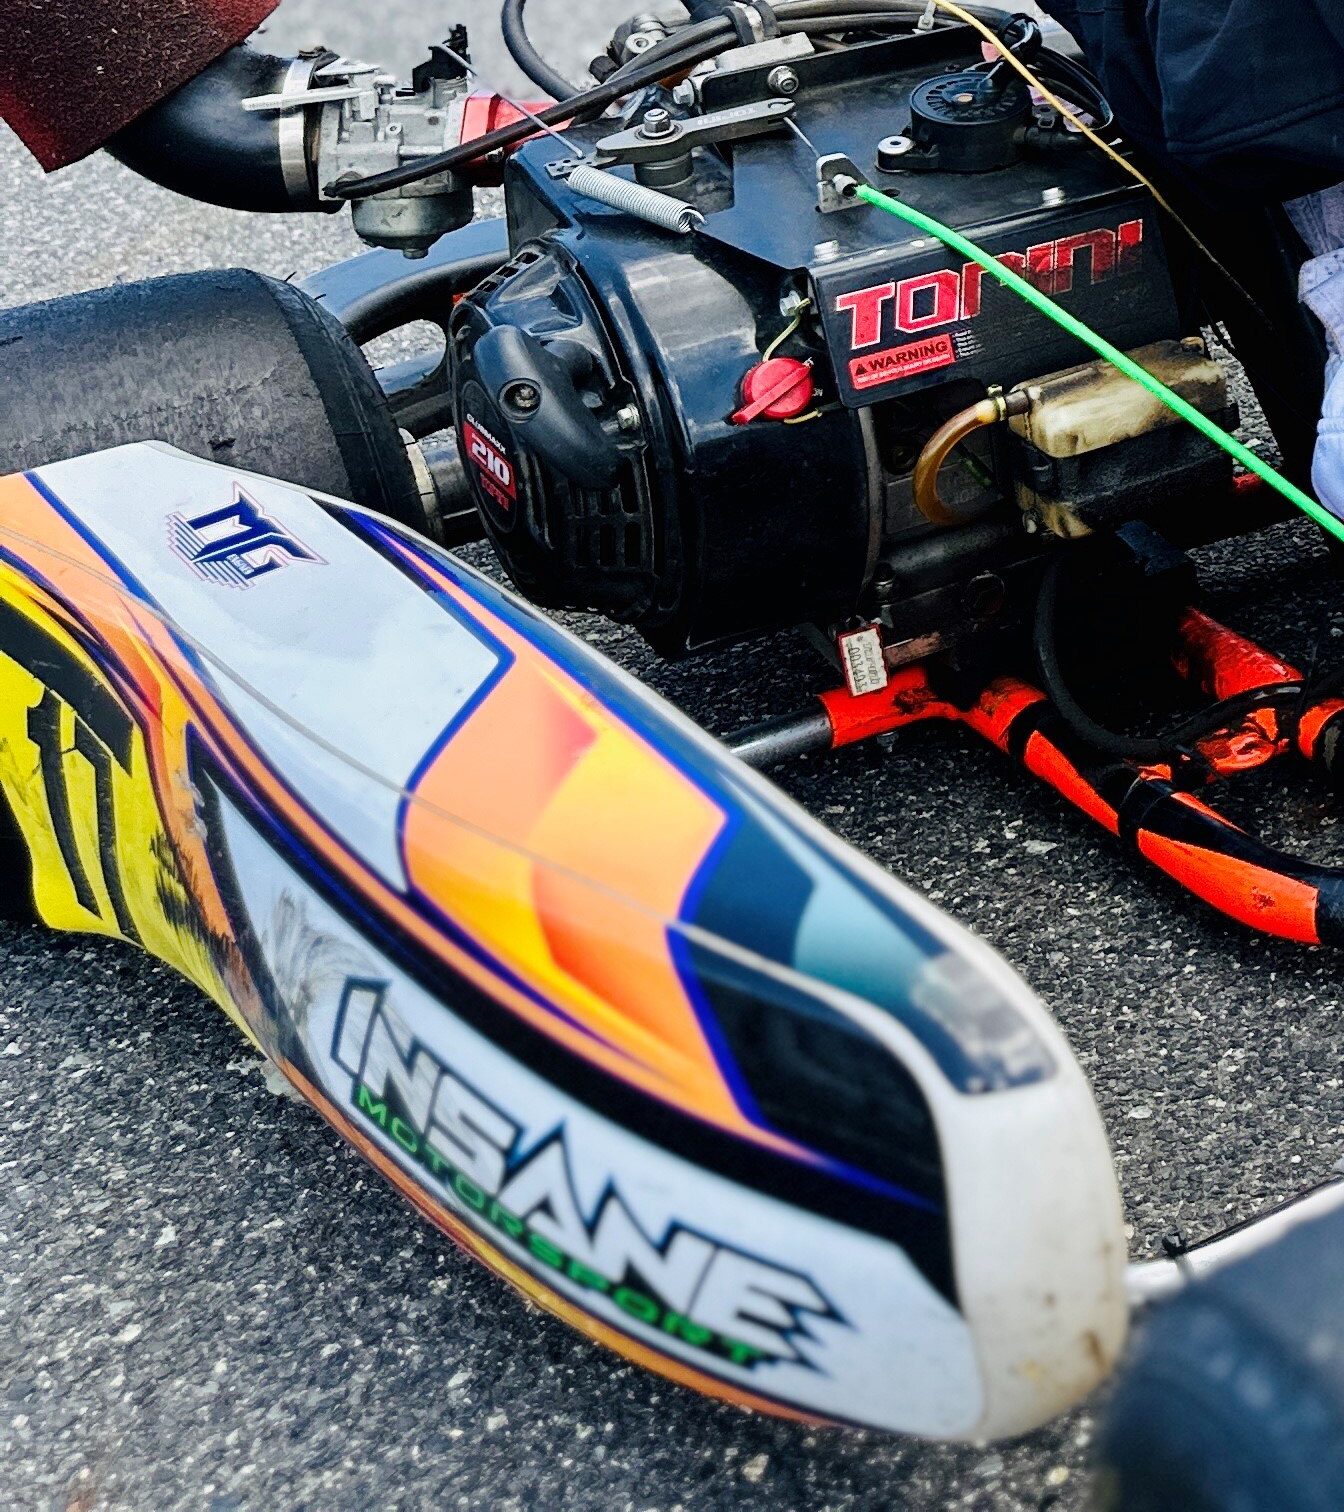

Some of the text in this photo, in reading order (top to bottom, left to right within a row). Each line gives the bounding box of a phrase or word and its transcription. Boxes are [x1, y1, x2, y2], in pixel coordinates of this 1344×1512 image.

[868, 340, 949, 372] WARNING
[471, 432, 510, 486] 210
[331, 974, 856, 1372] INSANE
[357, 1081, 764, 1365] MOTORSPORT
